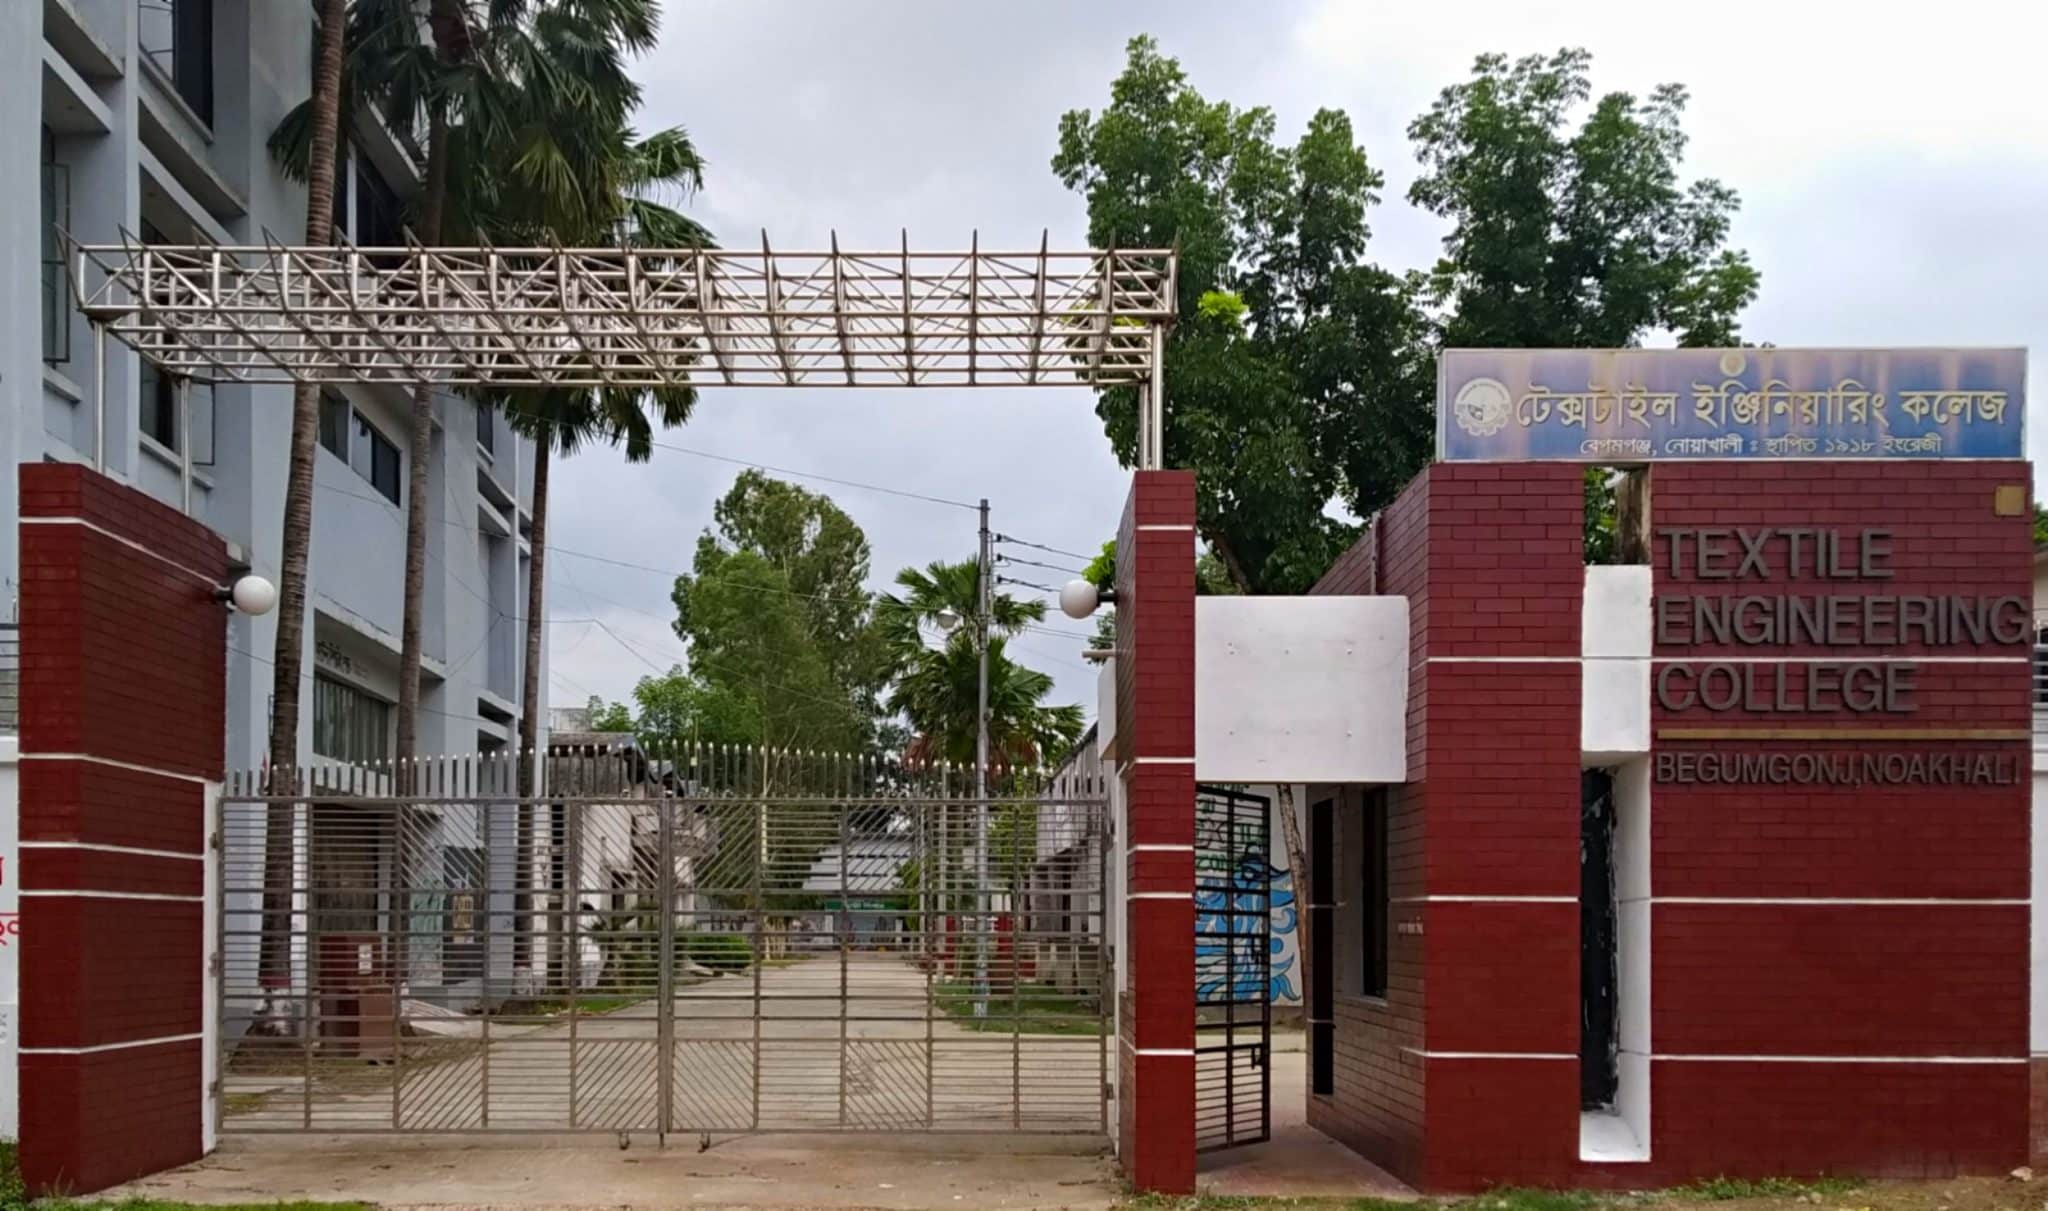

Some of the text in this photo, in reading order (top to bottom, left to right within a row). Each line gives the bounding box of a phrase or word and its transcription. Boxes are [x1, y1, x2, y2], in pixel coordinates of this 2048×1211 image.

[1516, 378, 2009, 429] টেক্সটাইল ইঞ্জিনিয়ারিং কলেজ
[1825, 437, 1877, 453] ১৯১৮
[1657, 527, 1896, 579] TEXTILE
[1656, 594, 2029, 646] ENGINEERING
[1657, 661, 1919, 712] COLLEGE
